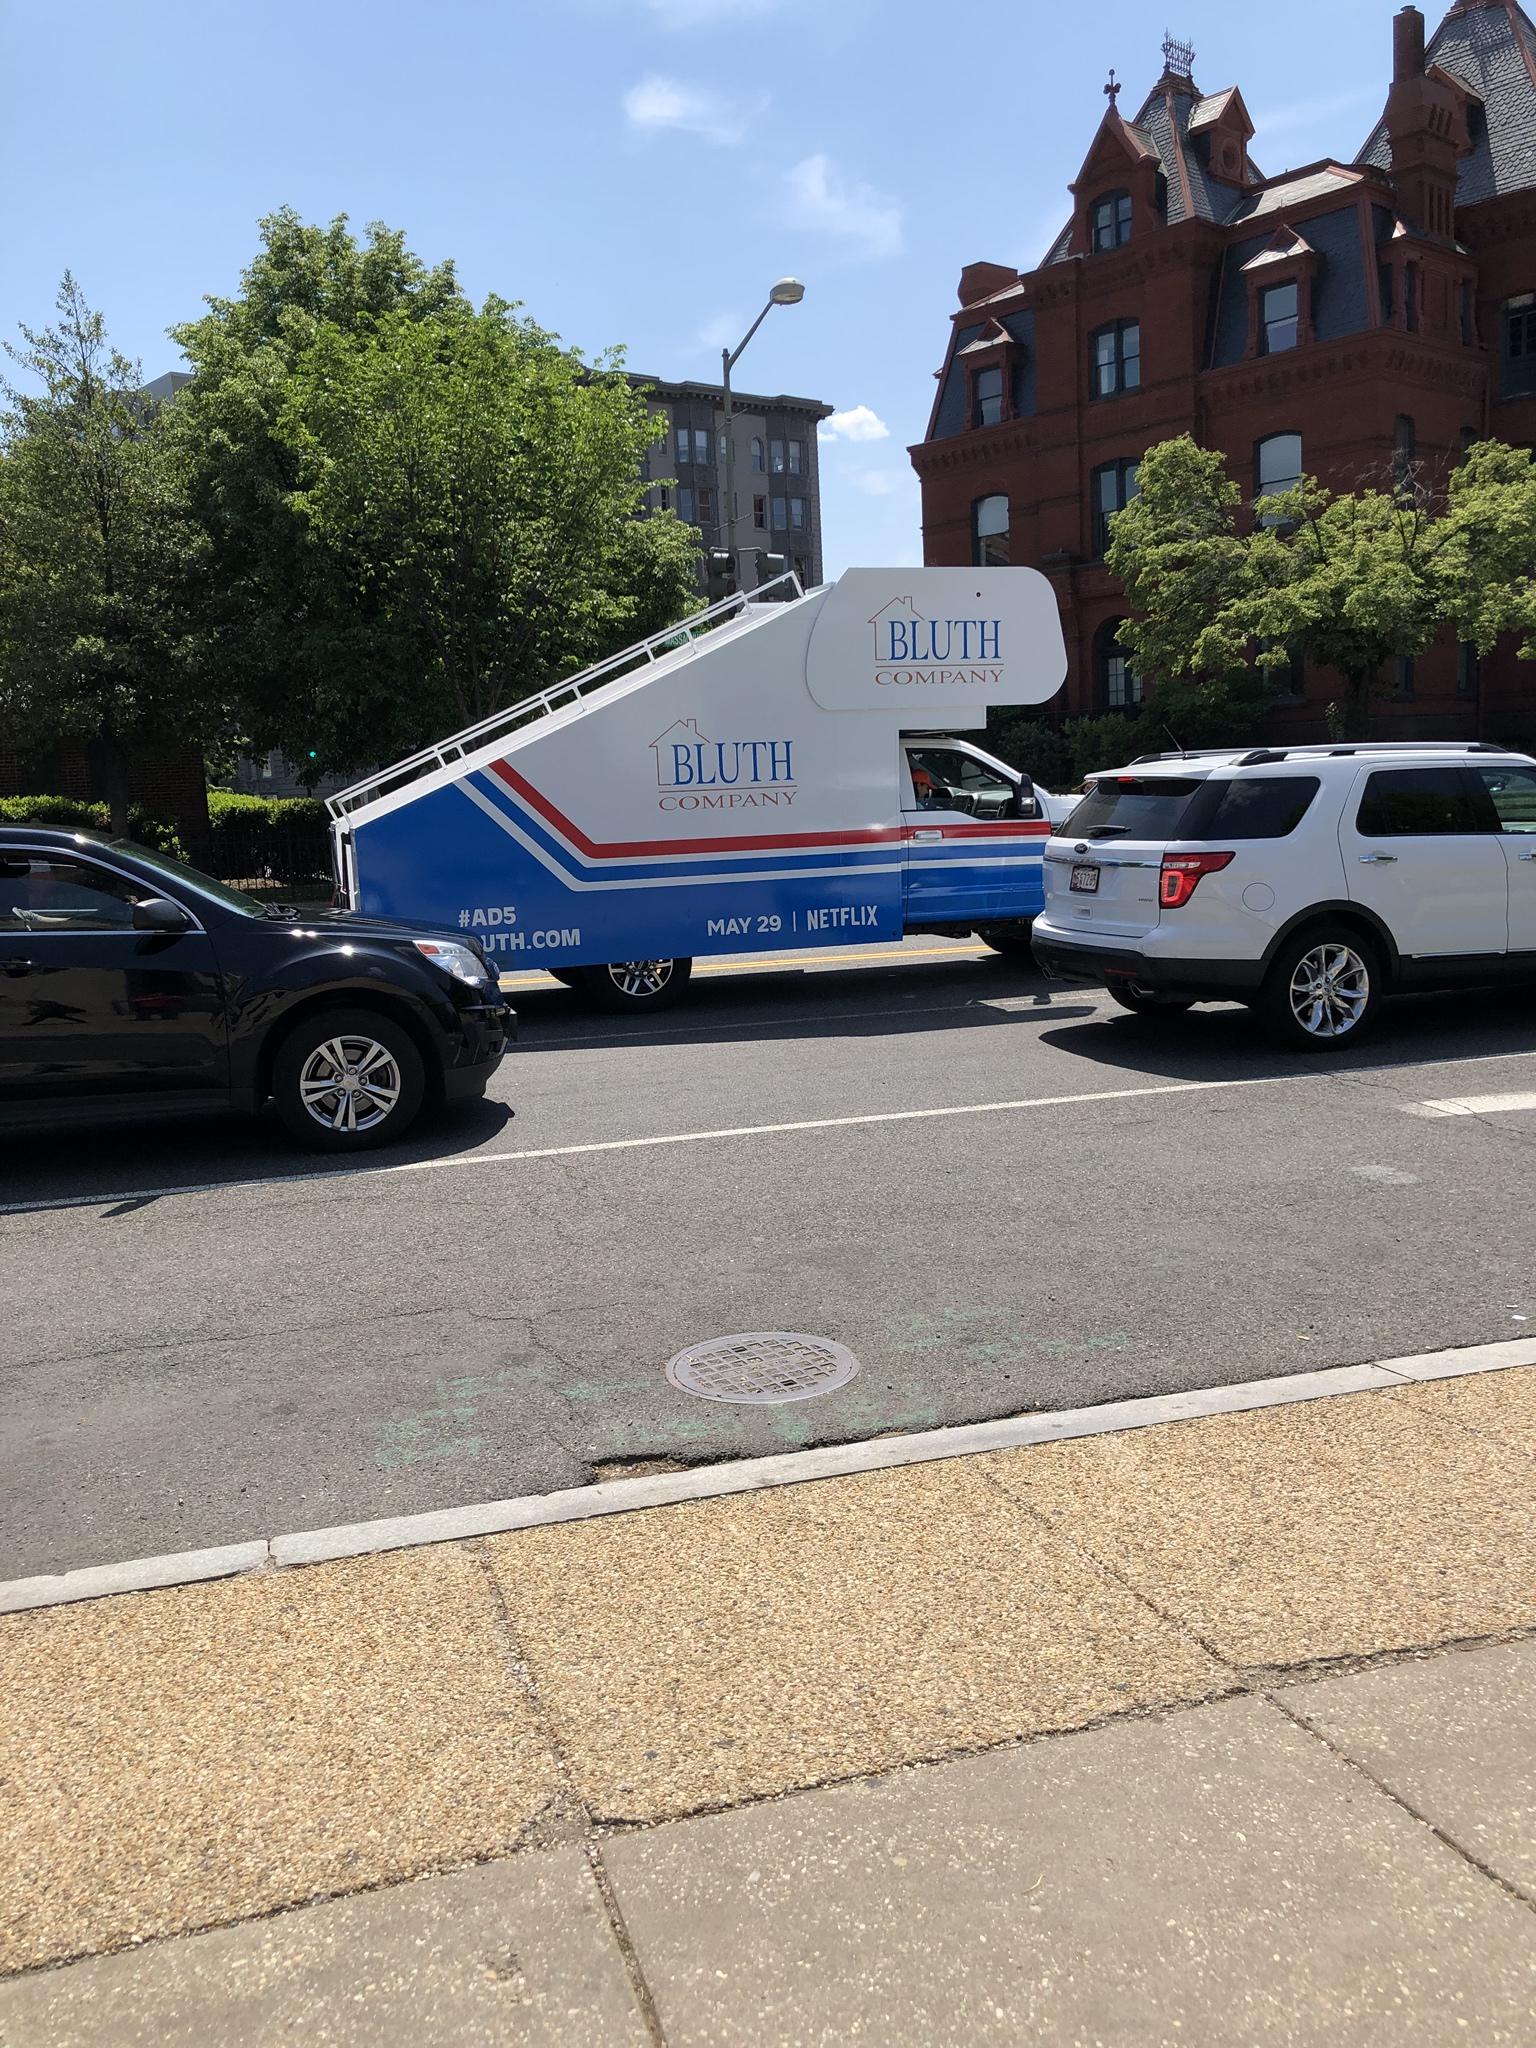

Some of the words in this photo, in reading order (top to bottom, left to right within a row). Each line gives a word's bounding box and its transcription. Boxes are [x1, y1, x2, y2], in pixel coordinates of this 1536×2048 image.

[888, 620, 1002, 661] BLUTH
[875, 669, 1005, 686] COMPANY
[672, 741, 793, 786] BLUTH
[658, 791, 798, 811] COMPANY
[458, 906, 517, 928] #AD5
[707, 917, 752, 936] MAY
[757, 914, 782, 933] 29
[807, 905, 878, 931] NETFLIX
[482, 928, 581, 953] UTH.COM
